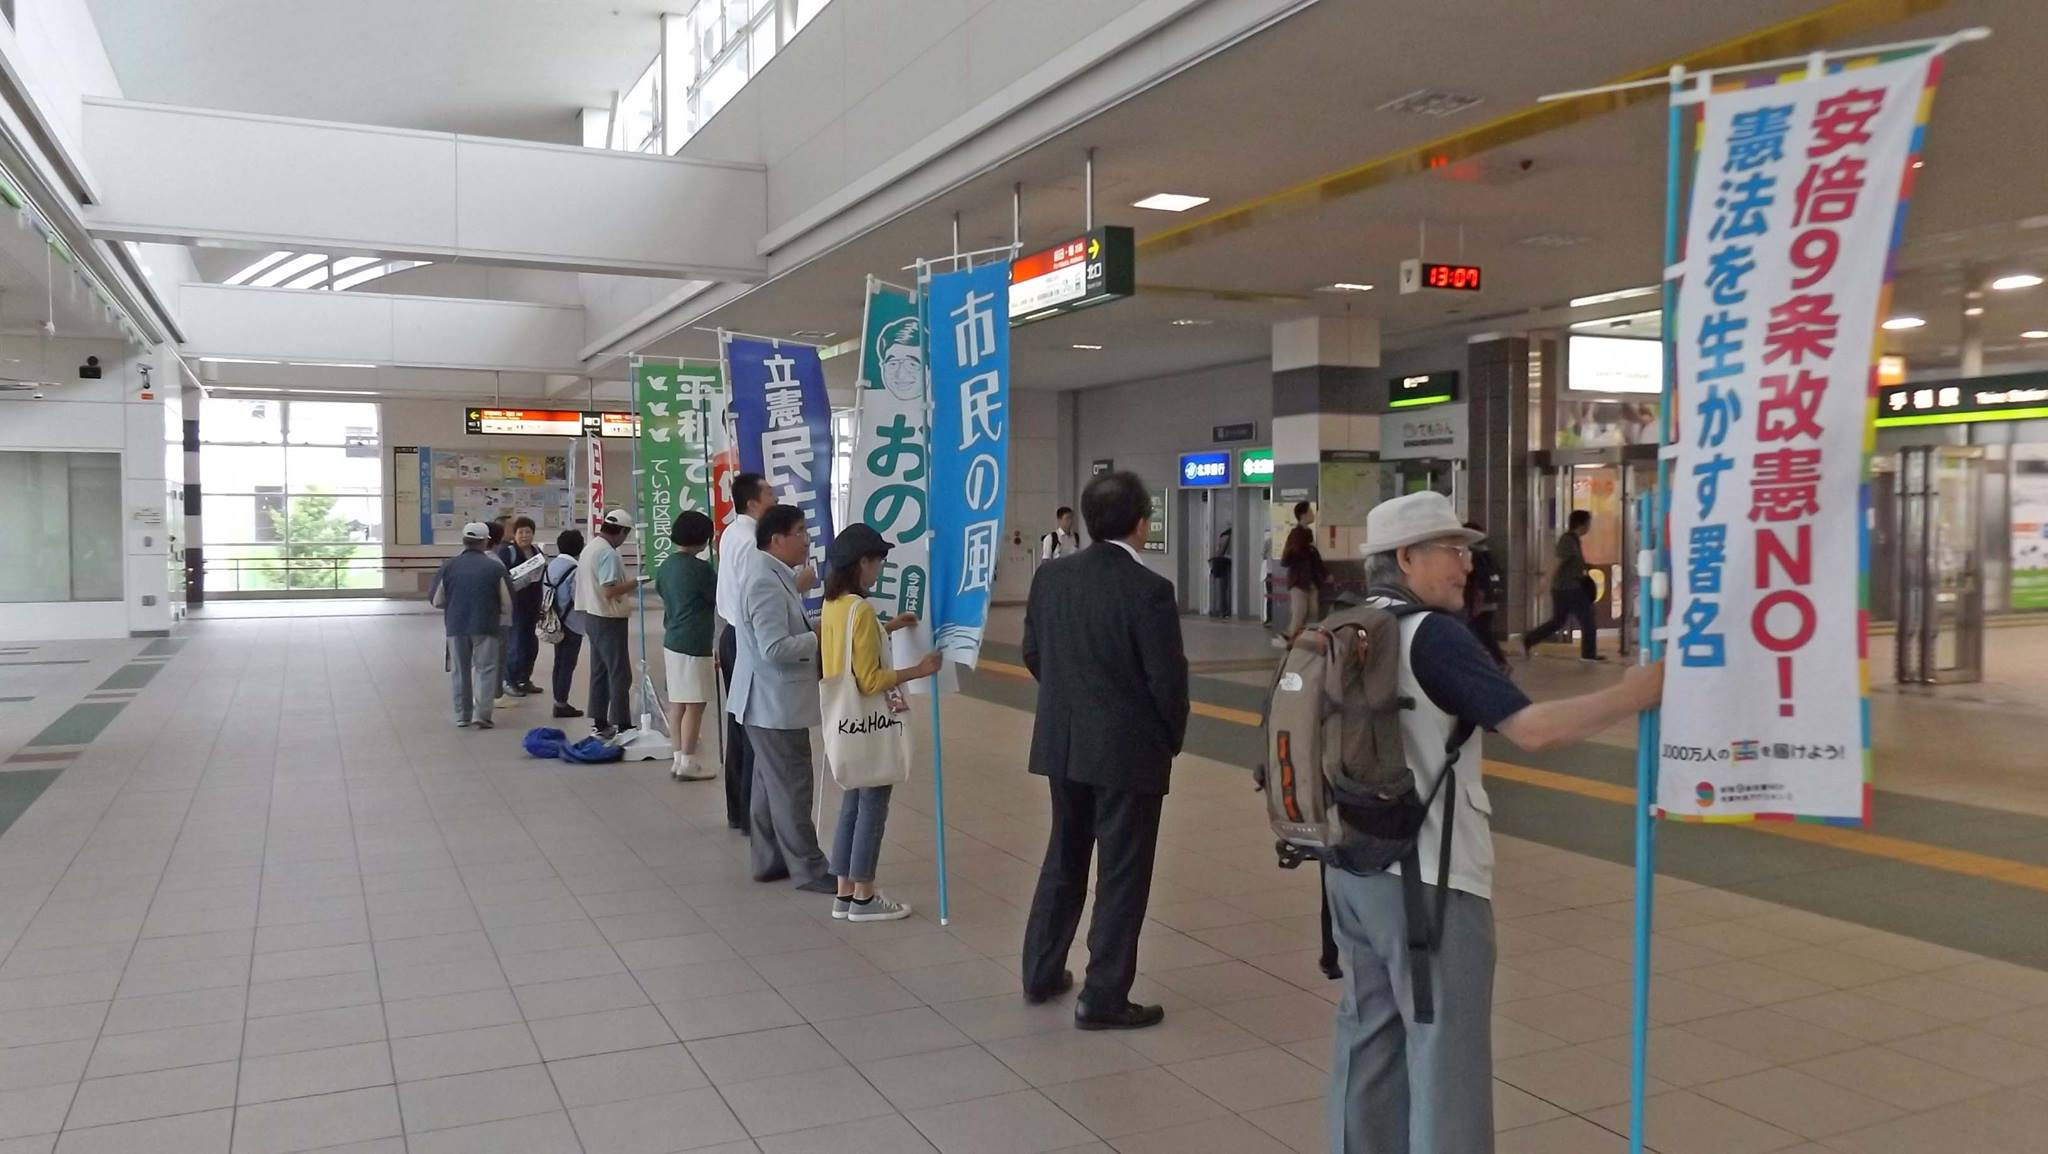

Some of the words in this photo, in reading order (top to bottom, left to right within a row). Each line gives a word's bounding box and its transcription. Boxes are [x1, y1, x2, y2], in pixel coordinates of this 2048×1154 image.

[1430, 266, 1478, 288] 13:07
[1677, 104, 1796, 667] 憲法を生かす署名
[950, 290, 1002, 597] 市民の風
